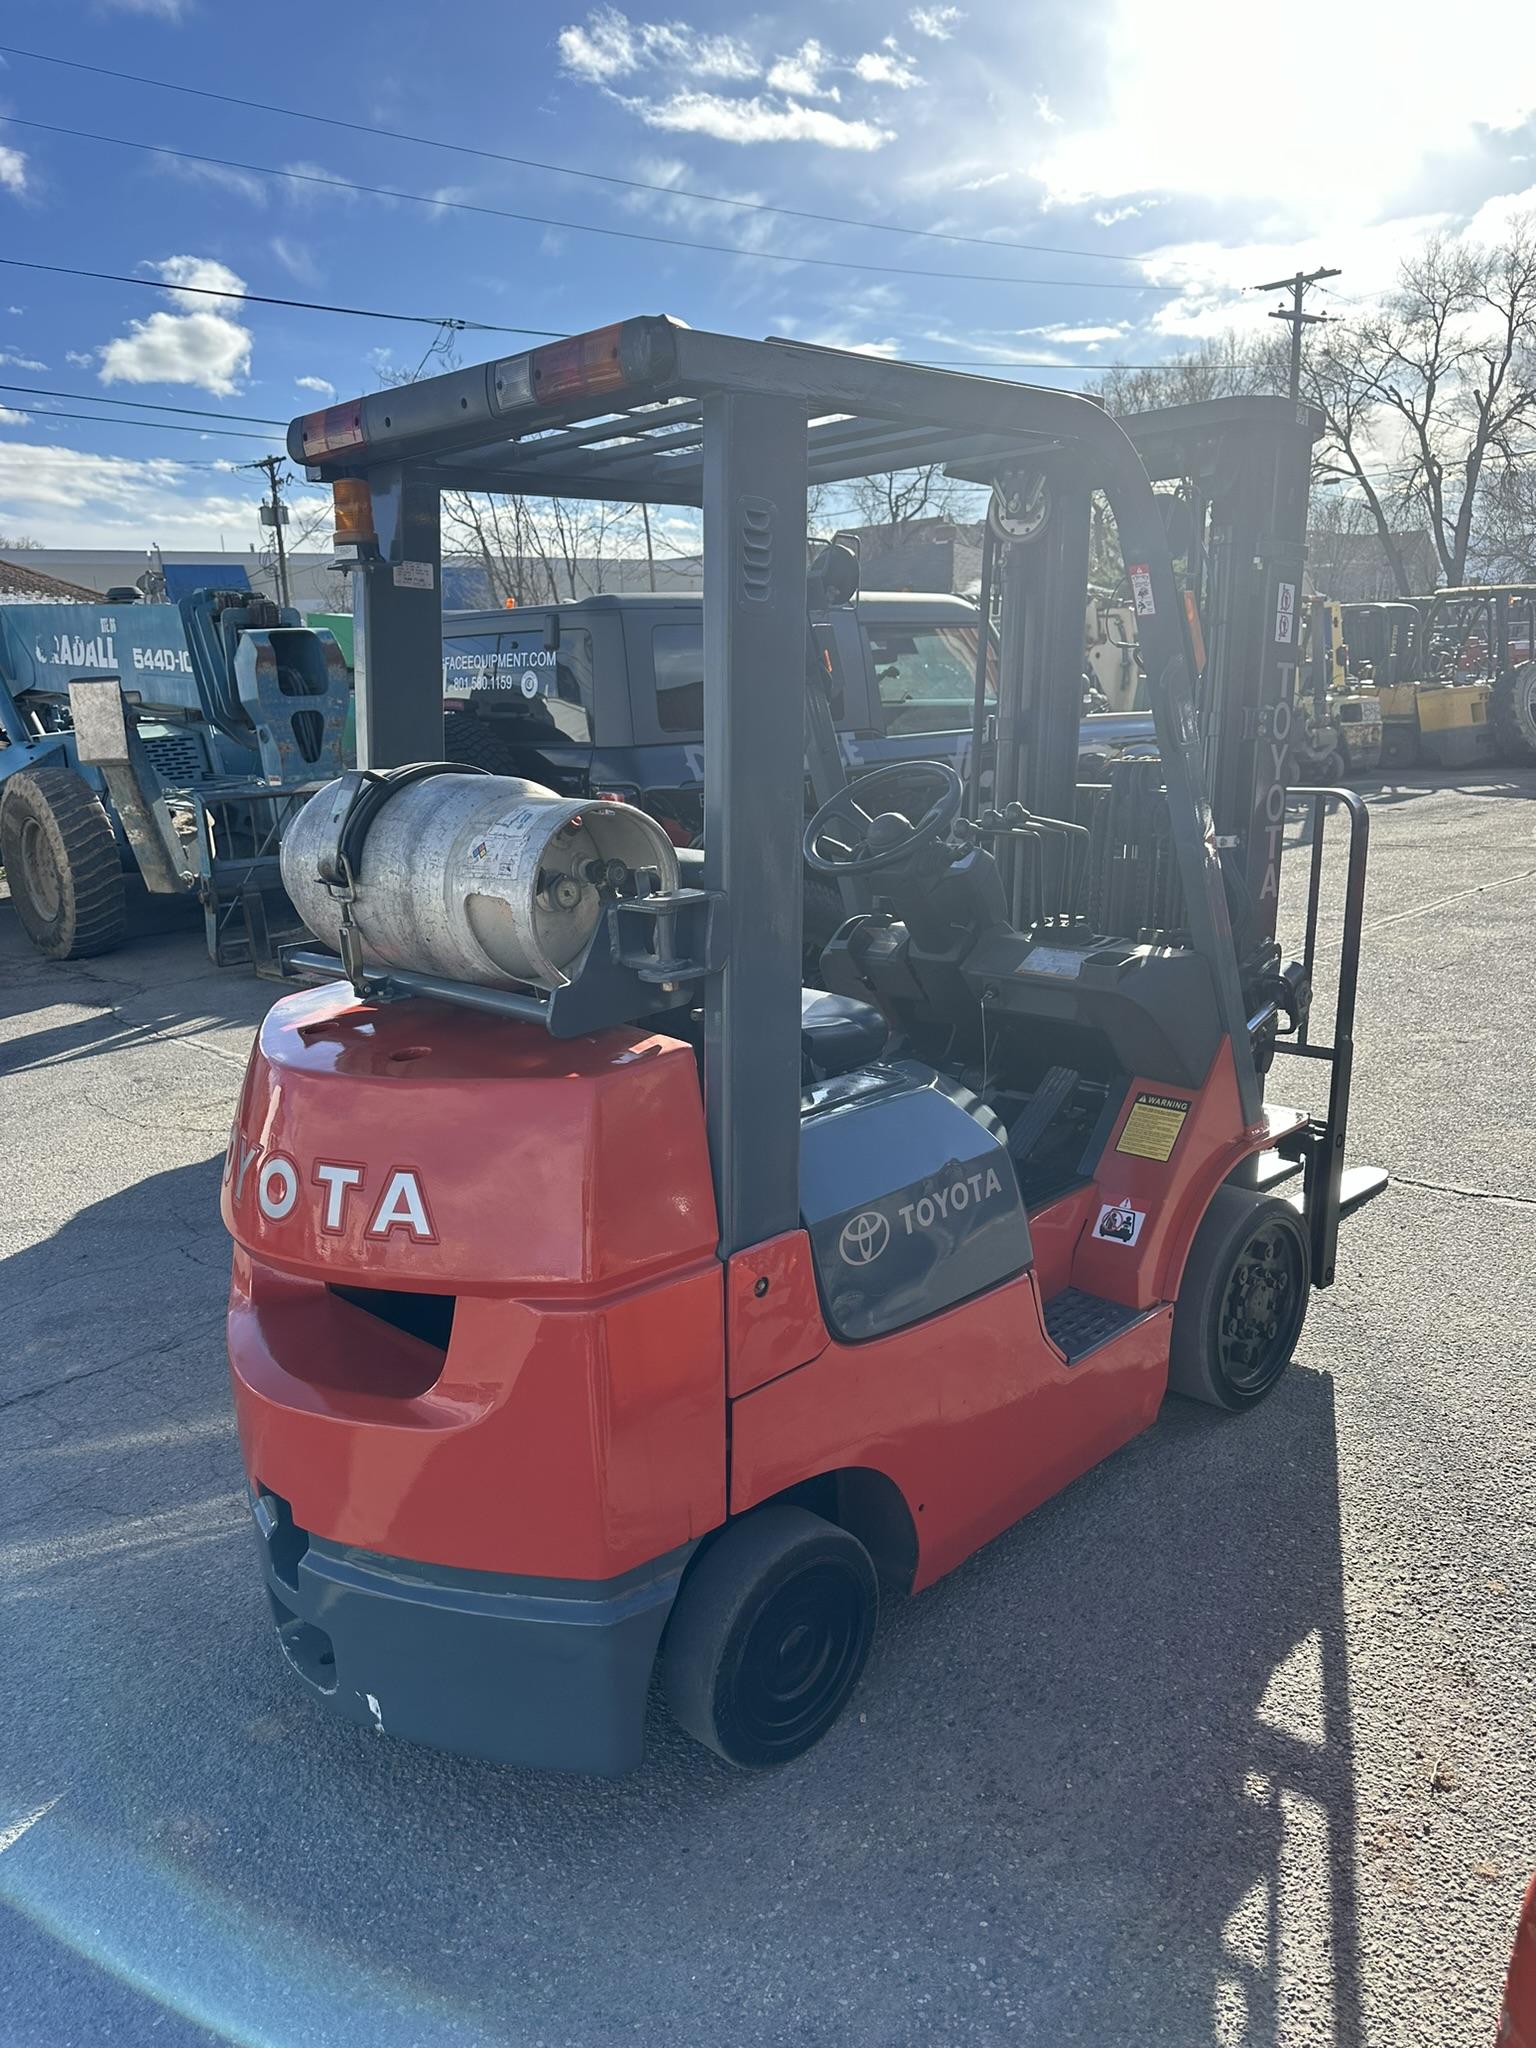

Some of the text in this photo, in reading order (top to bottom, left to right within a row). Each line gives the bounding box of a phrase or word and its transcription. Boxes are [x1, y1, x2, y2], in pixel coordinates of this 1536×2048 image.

[1260, 662, 1294, 899] TOYOTA
[1148, 1096, 1187, 1110] WARNING
[899, 1168, 1002, 1235] TOYOTA
